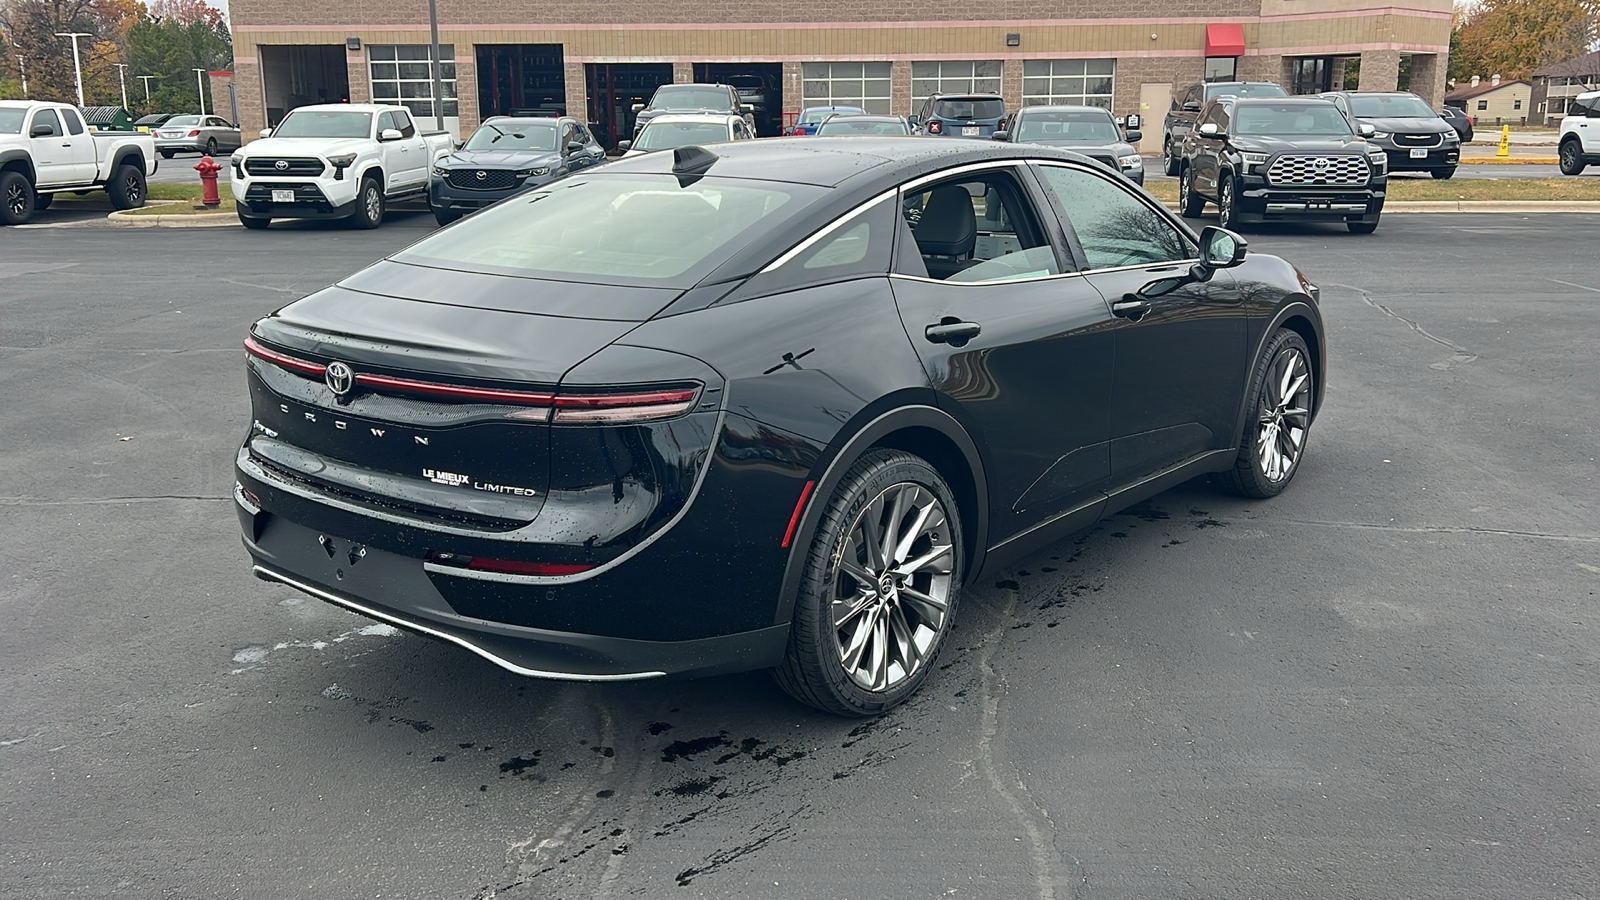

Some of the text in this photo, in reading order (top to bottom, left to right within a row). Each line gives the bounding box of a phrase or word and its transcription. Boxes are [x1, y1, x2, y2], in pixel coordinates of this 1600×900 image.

[280, 403, 429, 446] CROWN
[422, 468, 470, 485] LE MIEUX
[474, 481, 536, 497] LIMITED
